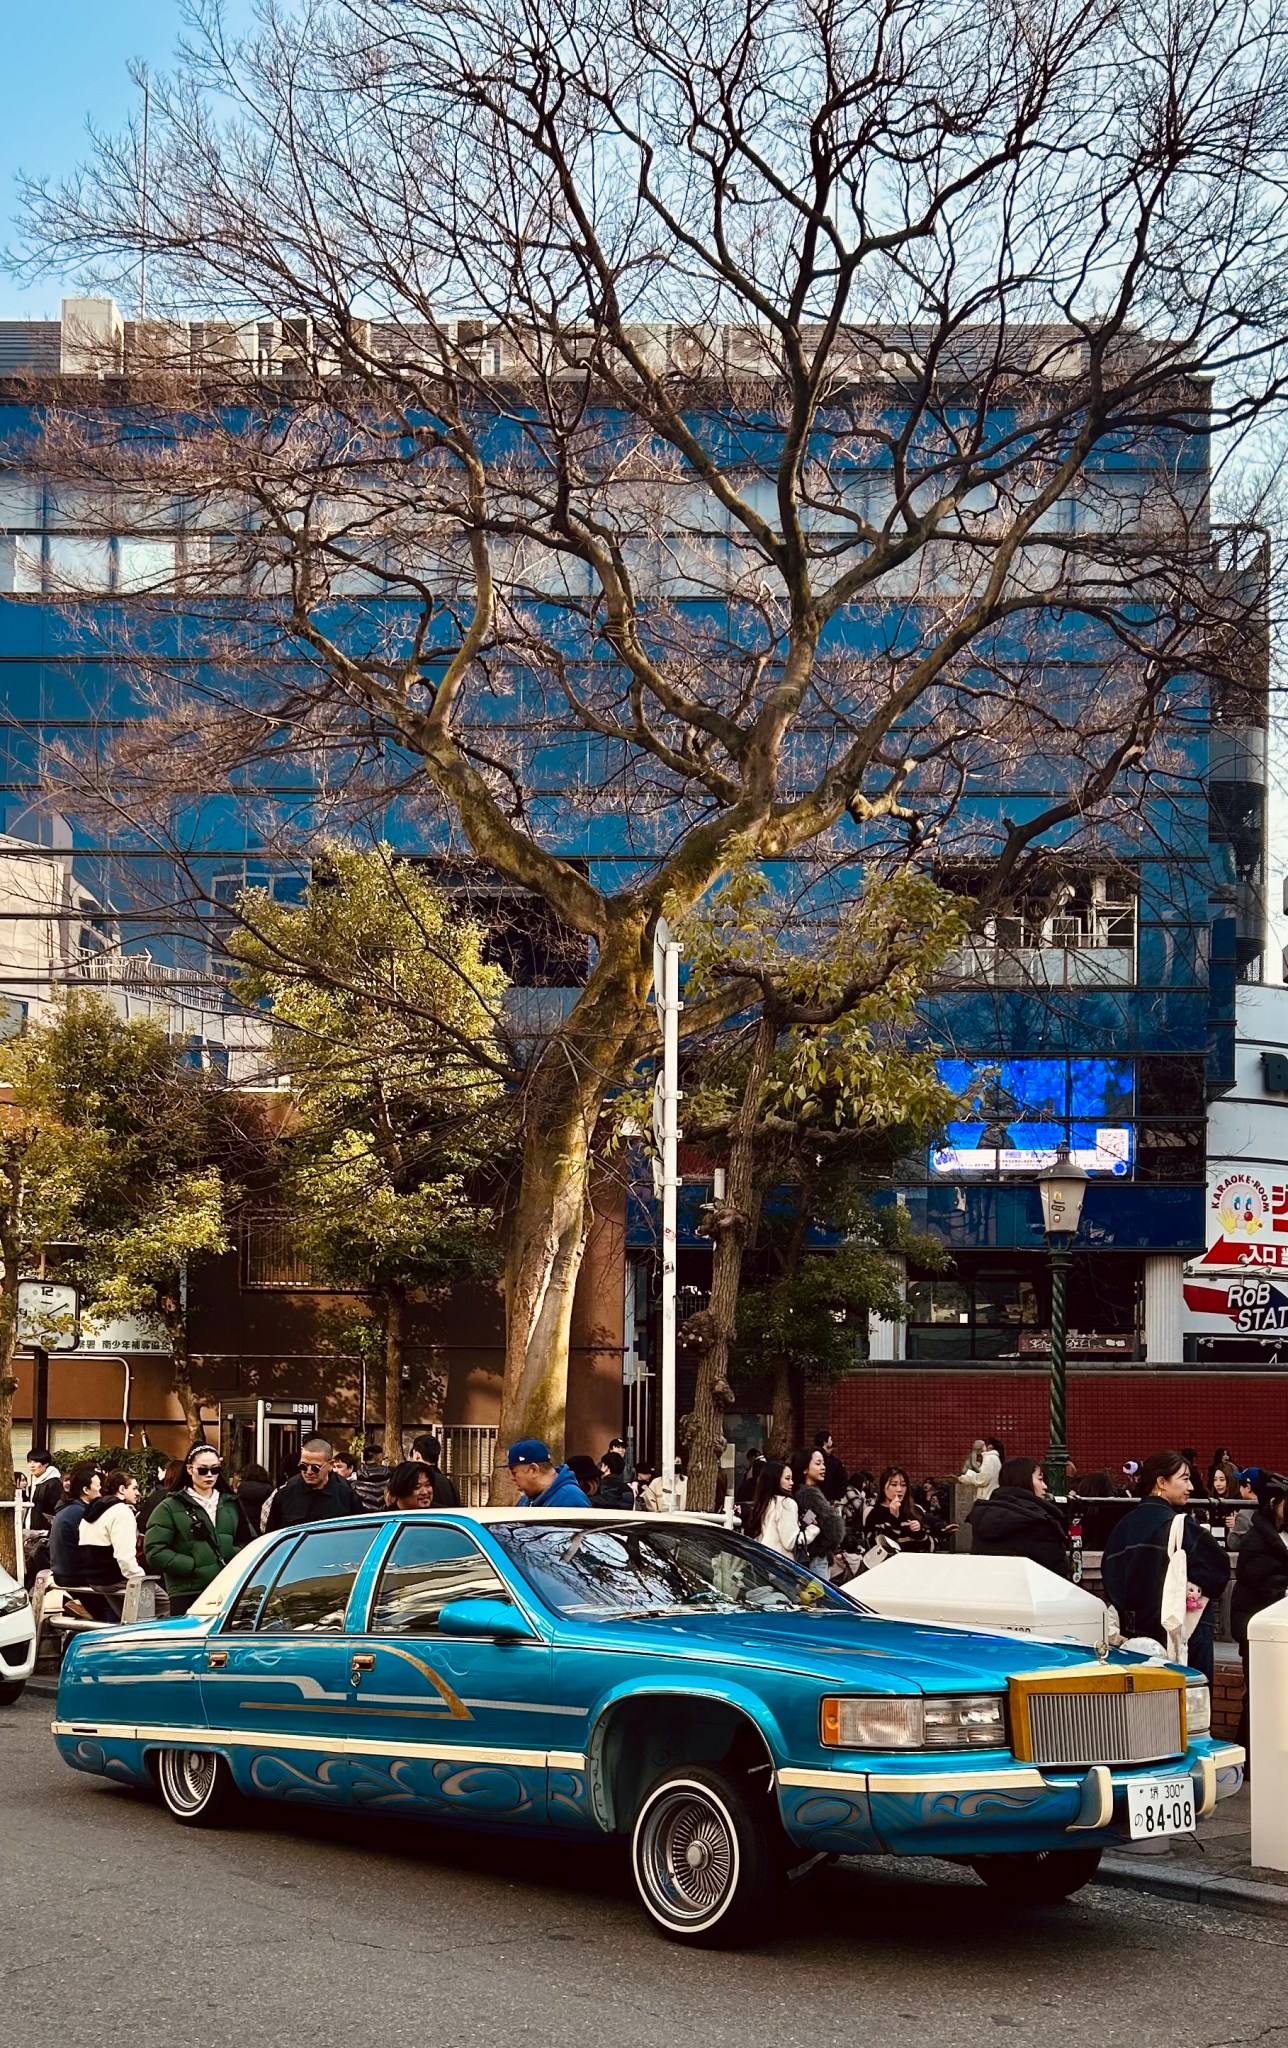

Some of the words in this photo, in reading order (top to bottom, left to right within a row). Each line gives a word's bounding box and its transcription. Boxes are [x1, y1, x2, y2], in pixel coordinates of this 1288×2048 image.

[1247, 1244, 1277, 1263] 入口
[41, 1286, 53, 1296] 12
[292, 1403, 315, 1414] ISDN
[1164, 1784, 1181, 1799] 300
[1134, 1813, 1144, 1828] の
[1145, 1801, 1192, 1833] 84-08
